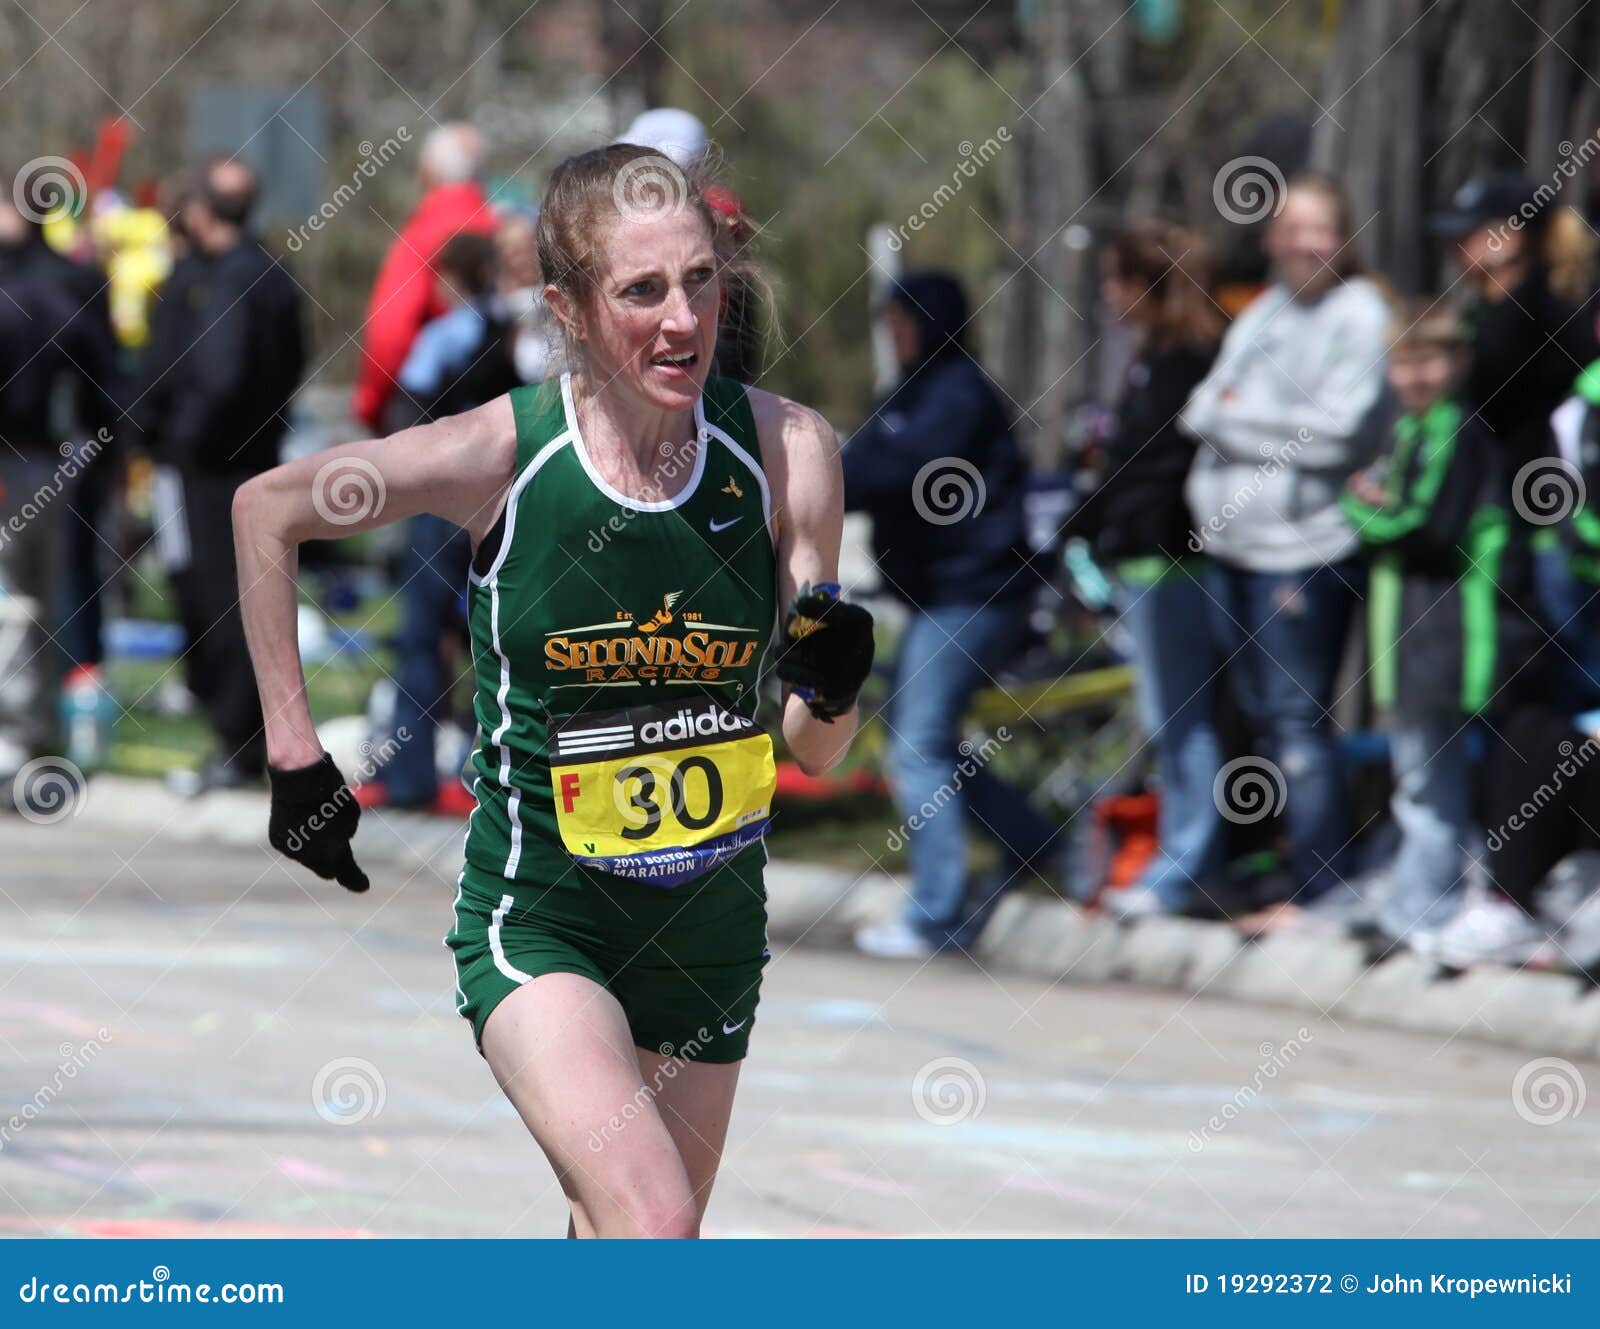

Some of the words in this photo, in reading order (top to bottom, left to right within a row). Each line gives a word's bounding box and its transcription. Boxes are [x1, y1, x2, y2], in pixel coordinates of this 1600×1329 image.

[682, 612, 702, 621] 1981
[586, 666, 721, 682] RACING
[560, 773, 581, 814] F
[614, 755, 723, 841] 30
[613, 858, 696, 878] MARATHON
[614, 857, 642, 869] 2011
[644, 850, 694, 865] BOSTON
